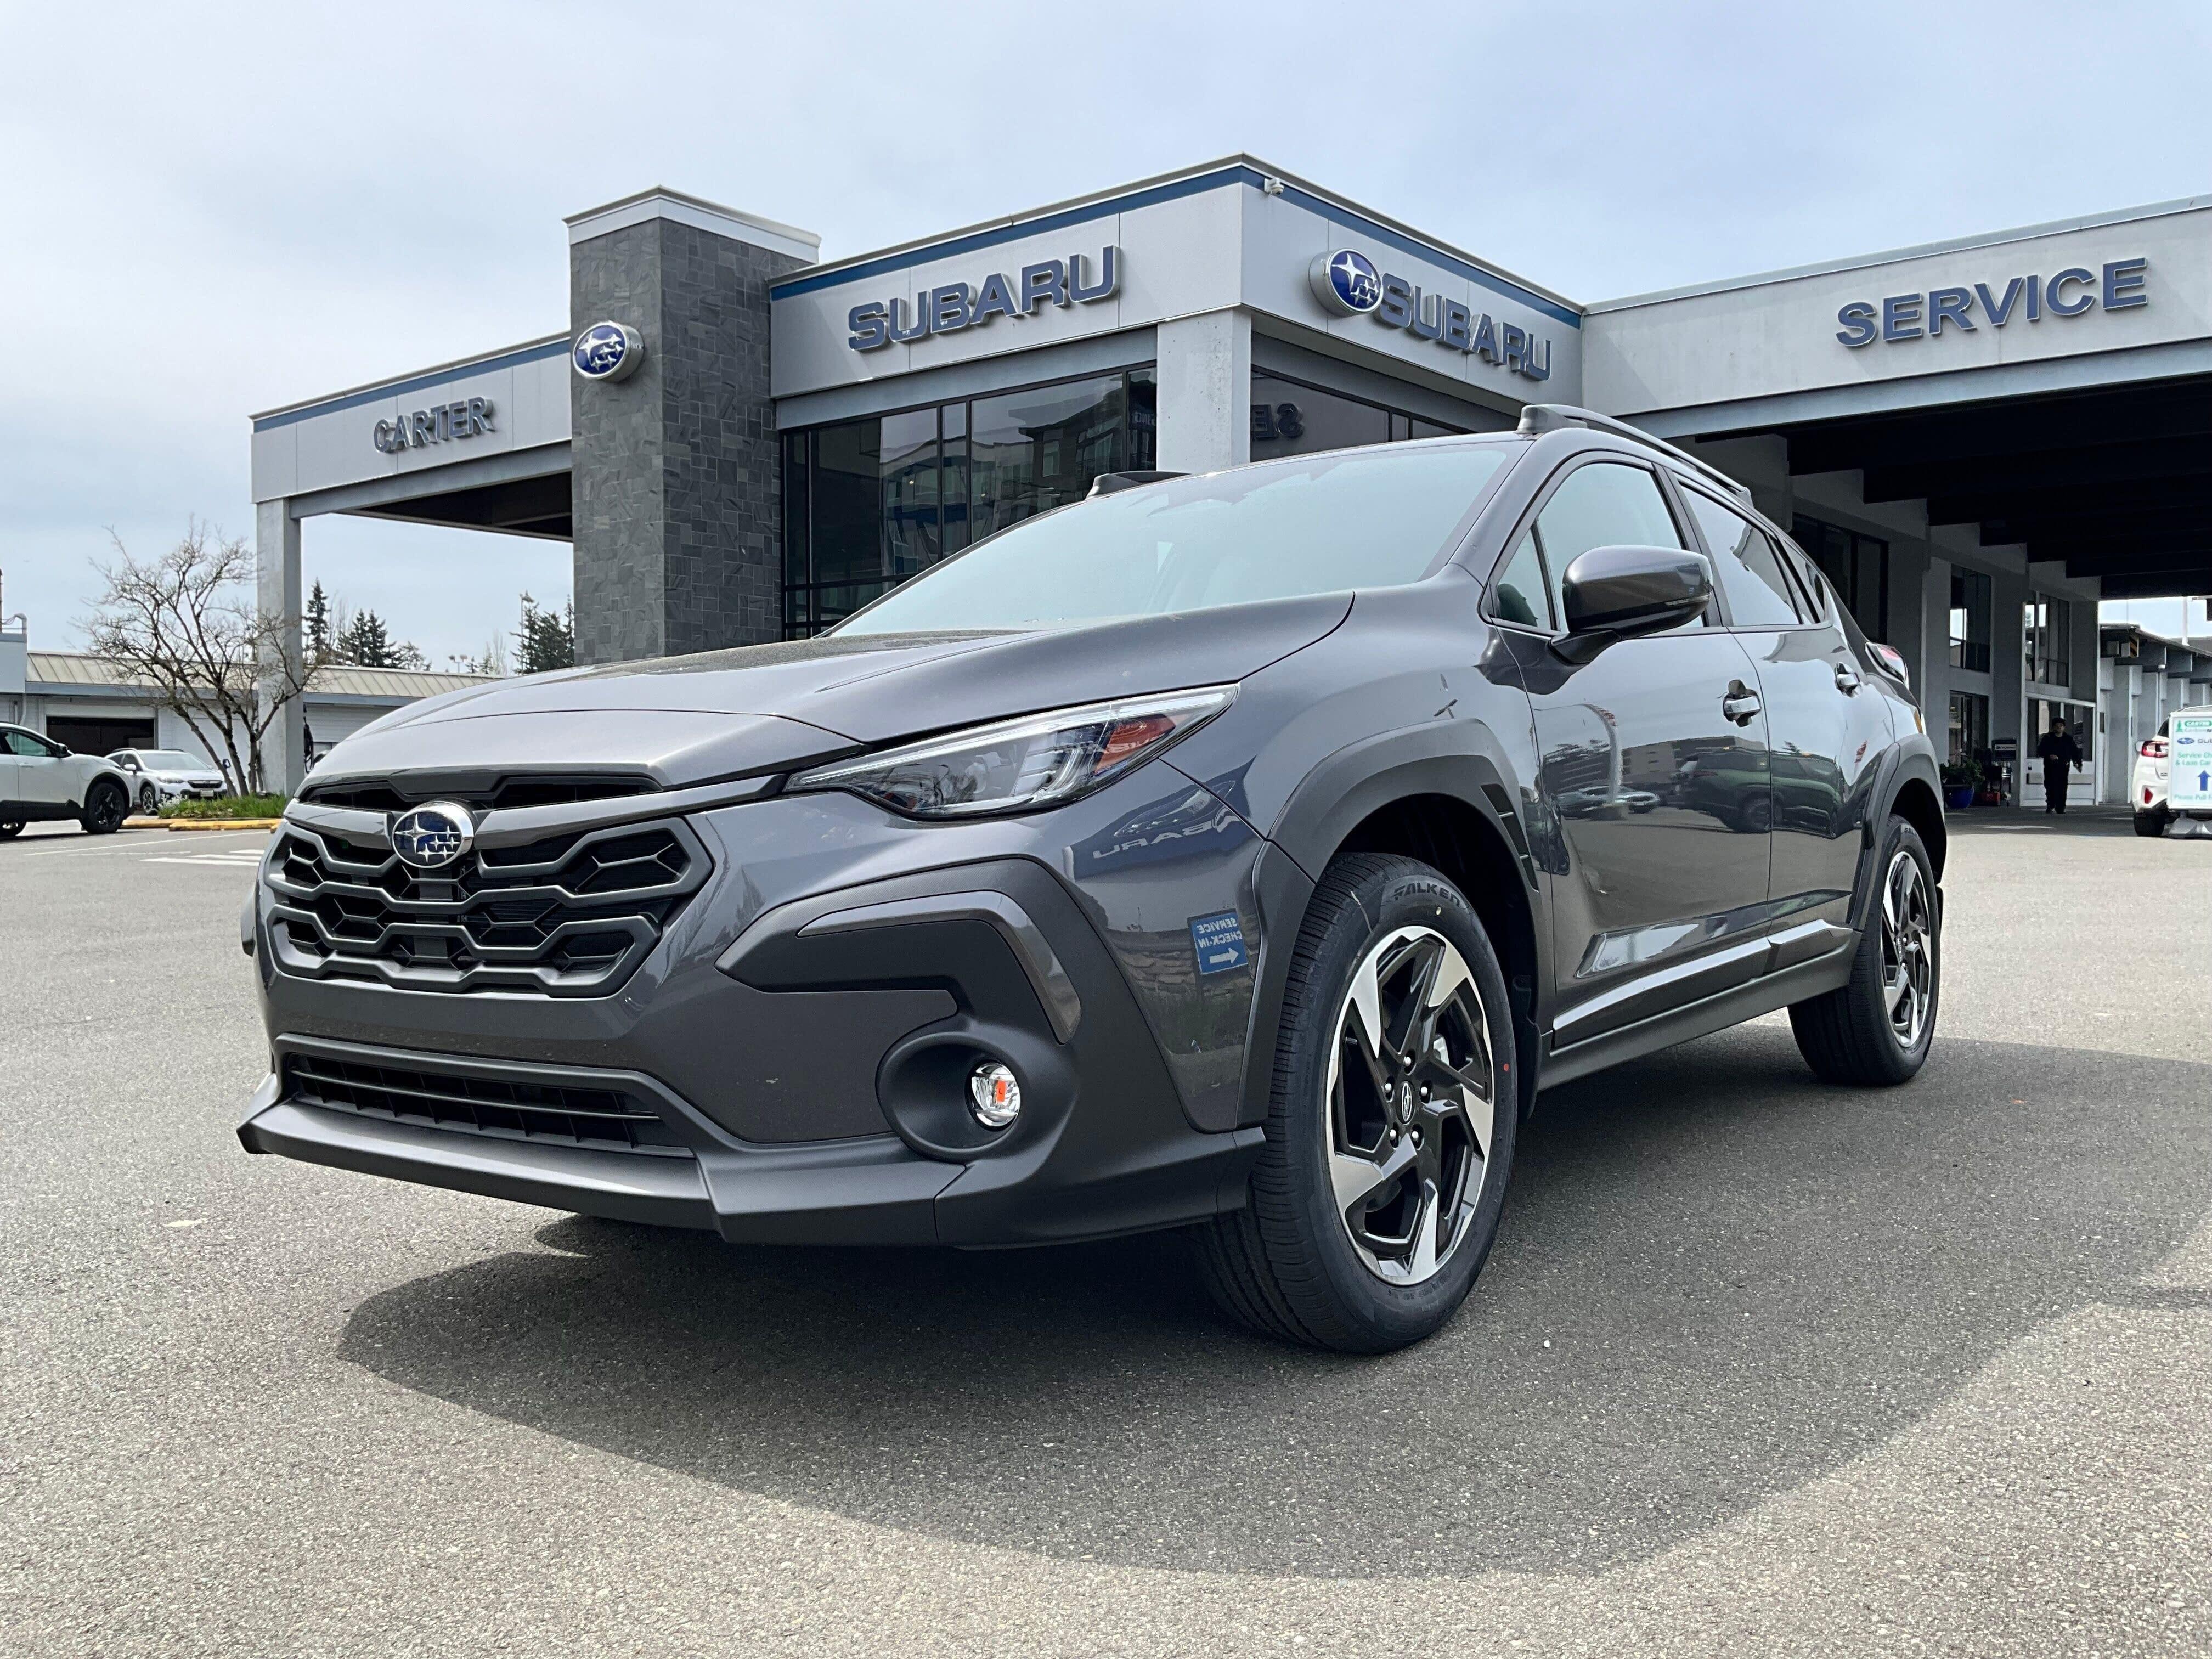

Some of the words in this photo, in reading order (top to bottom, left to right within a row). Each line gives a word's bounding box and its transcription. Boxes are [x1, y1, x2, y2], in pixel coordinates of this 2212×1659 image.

[848, 245, 1120, 351] SUBARU
[1375, 272, 1551, 381] SUBARU
[1835, 257, 2148, 347] SERVICE
[373, 396, 496, 453] CARTER
[1392, 882, 1460, 907] FALKEN
